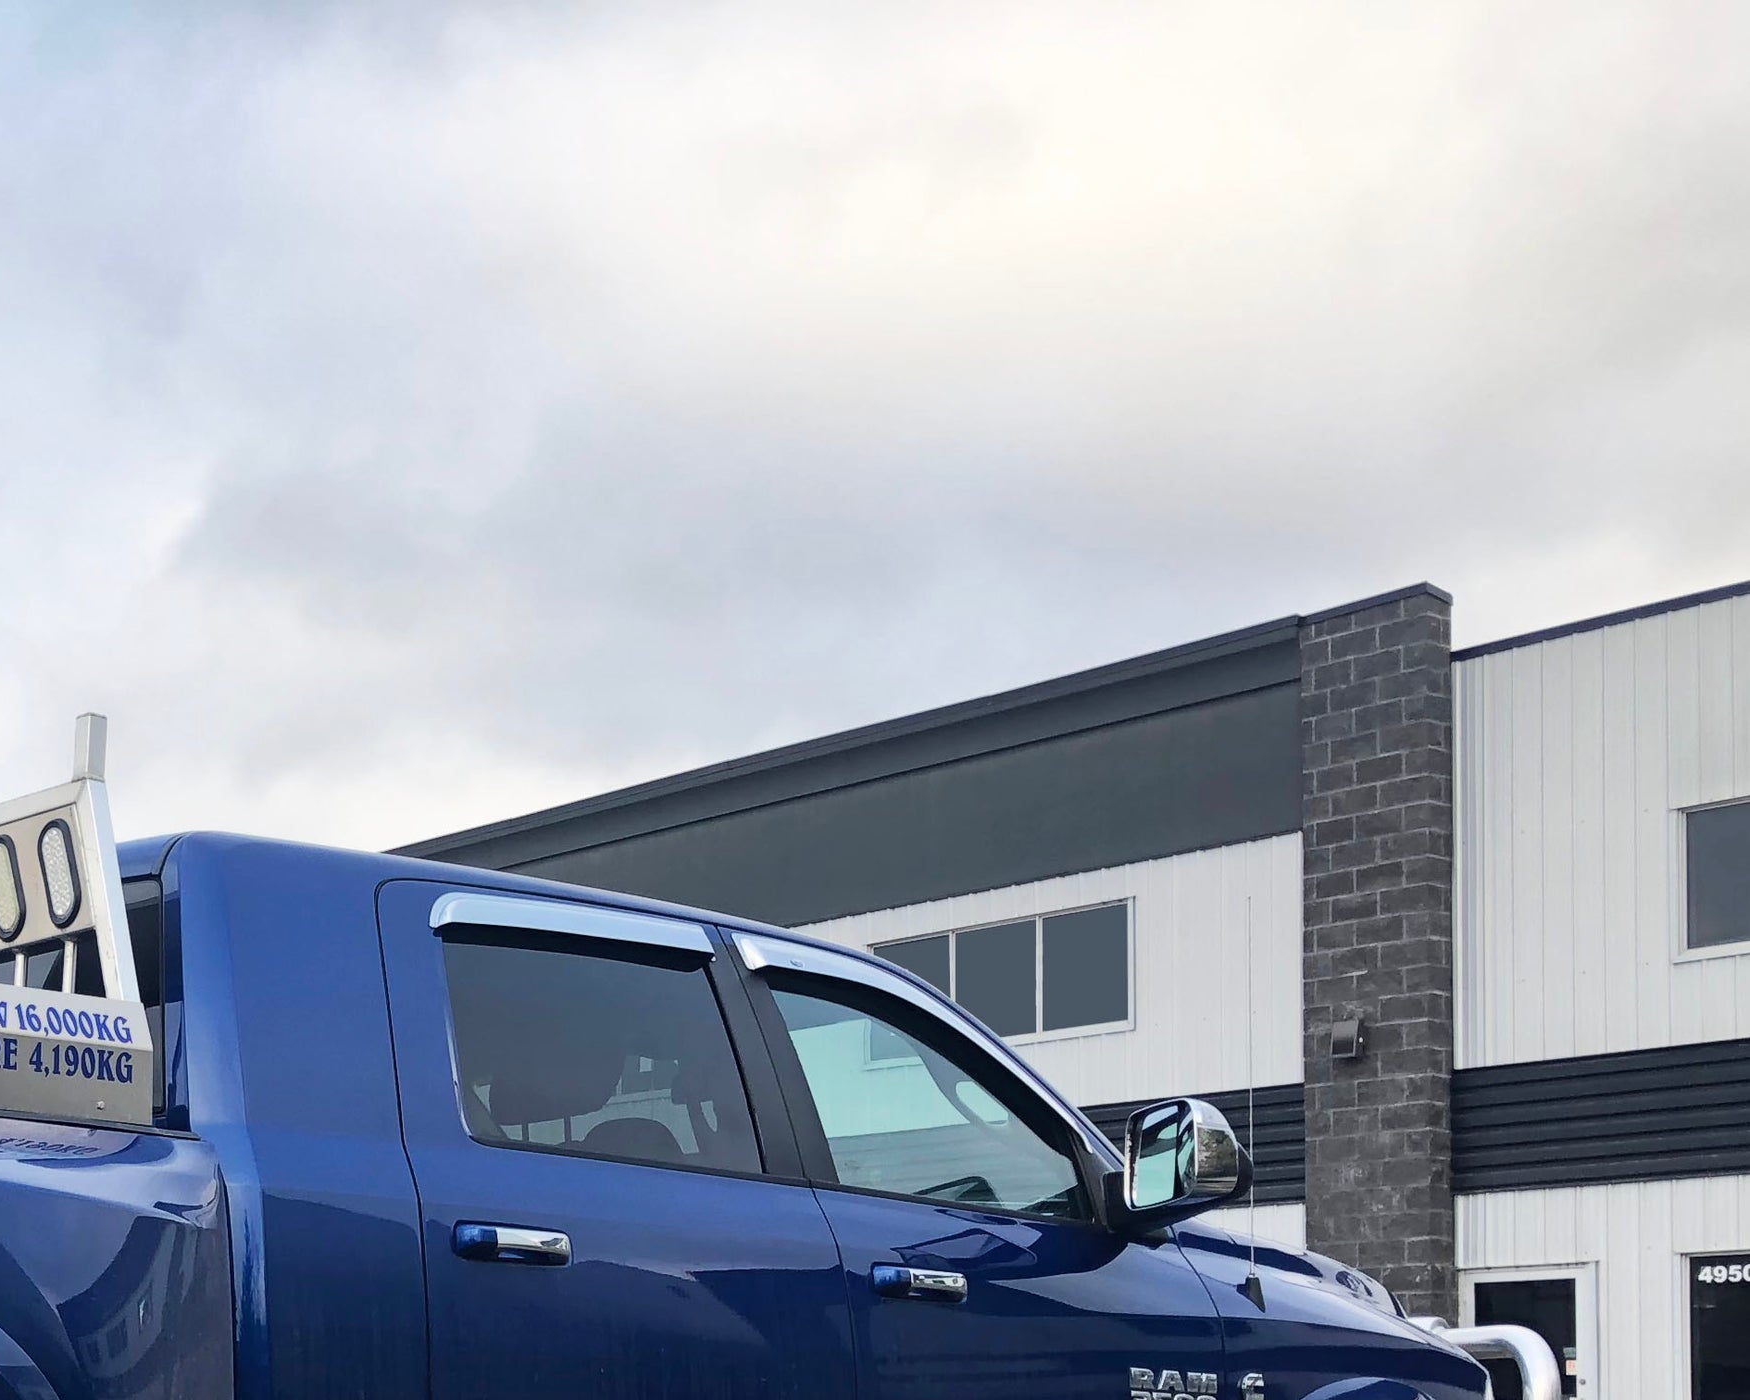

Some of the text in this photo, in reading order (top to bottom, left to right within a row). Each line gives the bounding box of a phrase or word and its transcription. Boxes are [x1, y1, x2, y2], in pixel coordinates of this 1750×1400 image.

[15, 1004, 133, 1043] 16,000KG
[29, 1042, 133, 1083] 4,190KG
[1129, 1367, 1218, 1394] RAM
